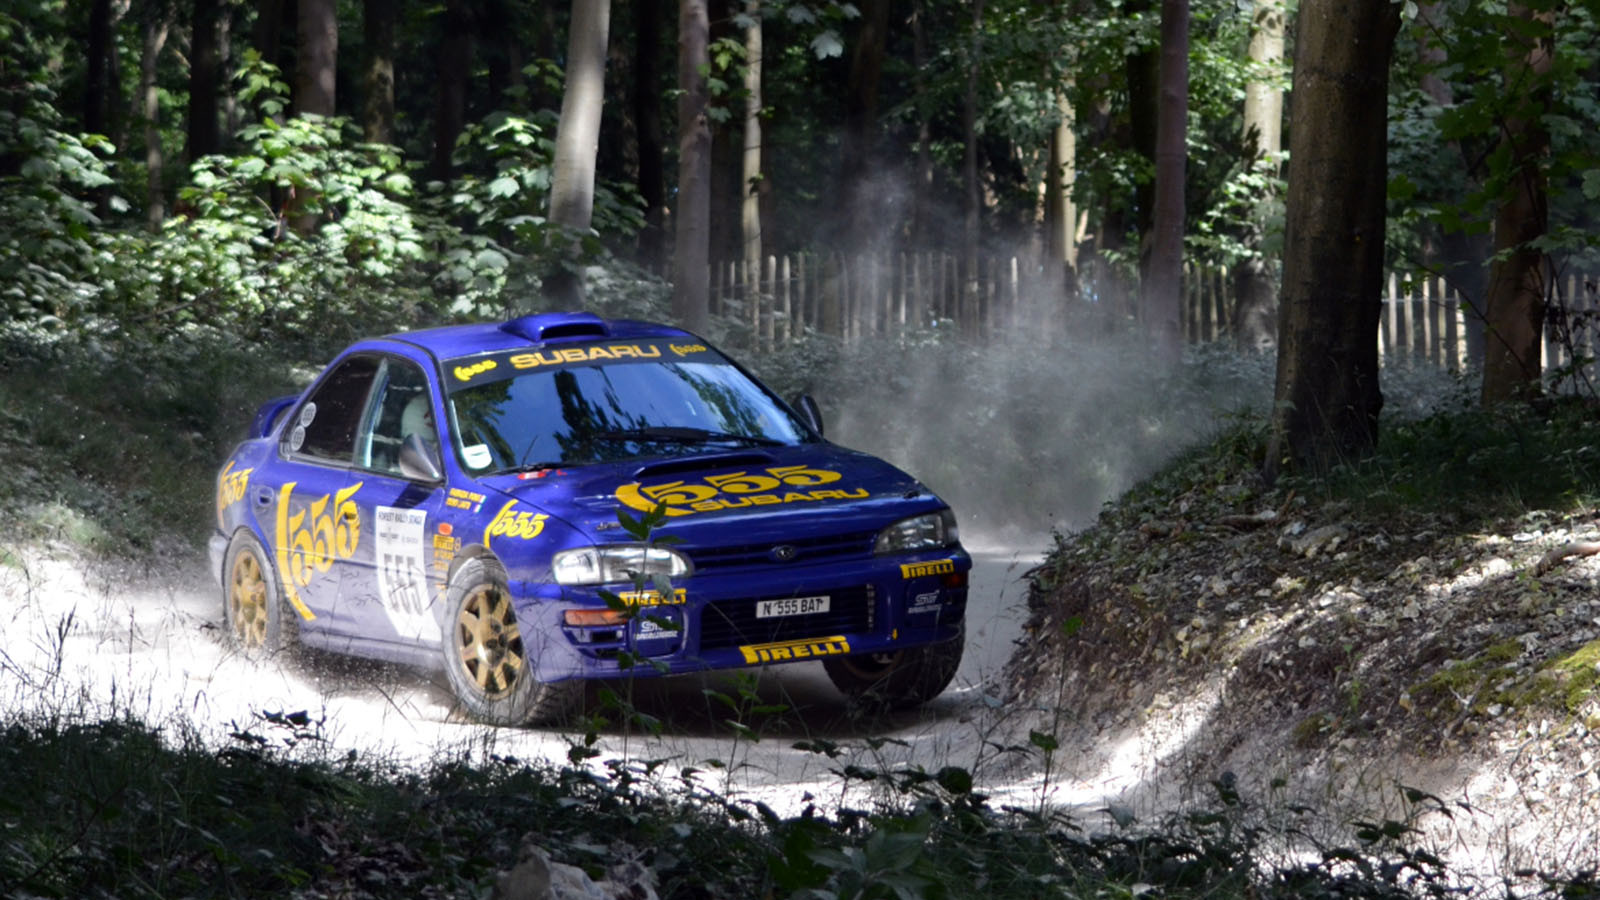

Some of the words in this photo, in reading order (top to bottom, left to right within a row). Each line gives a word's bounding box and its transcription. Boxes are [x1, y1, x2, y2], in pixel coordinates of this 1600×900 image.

[510, 345, 661, 369] SUBARU
[642, 465, 842, 505] 555
[690, 488, 870, 512] SUBARU
[289, 481, 363, 587] 555
[491, 509, 550, 540] 555
[900, 558, 955, 579] PIRELLI
[739, 635, 851, 664] PIRELLI
